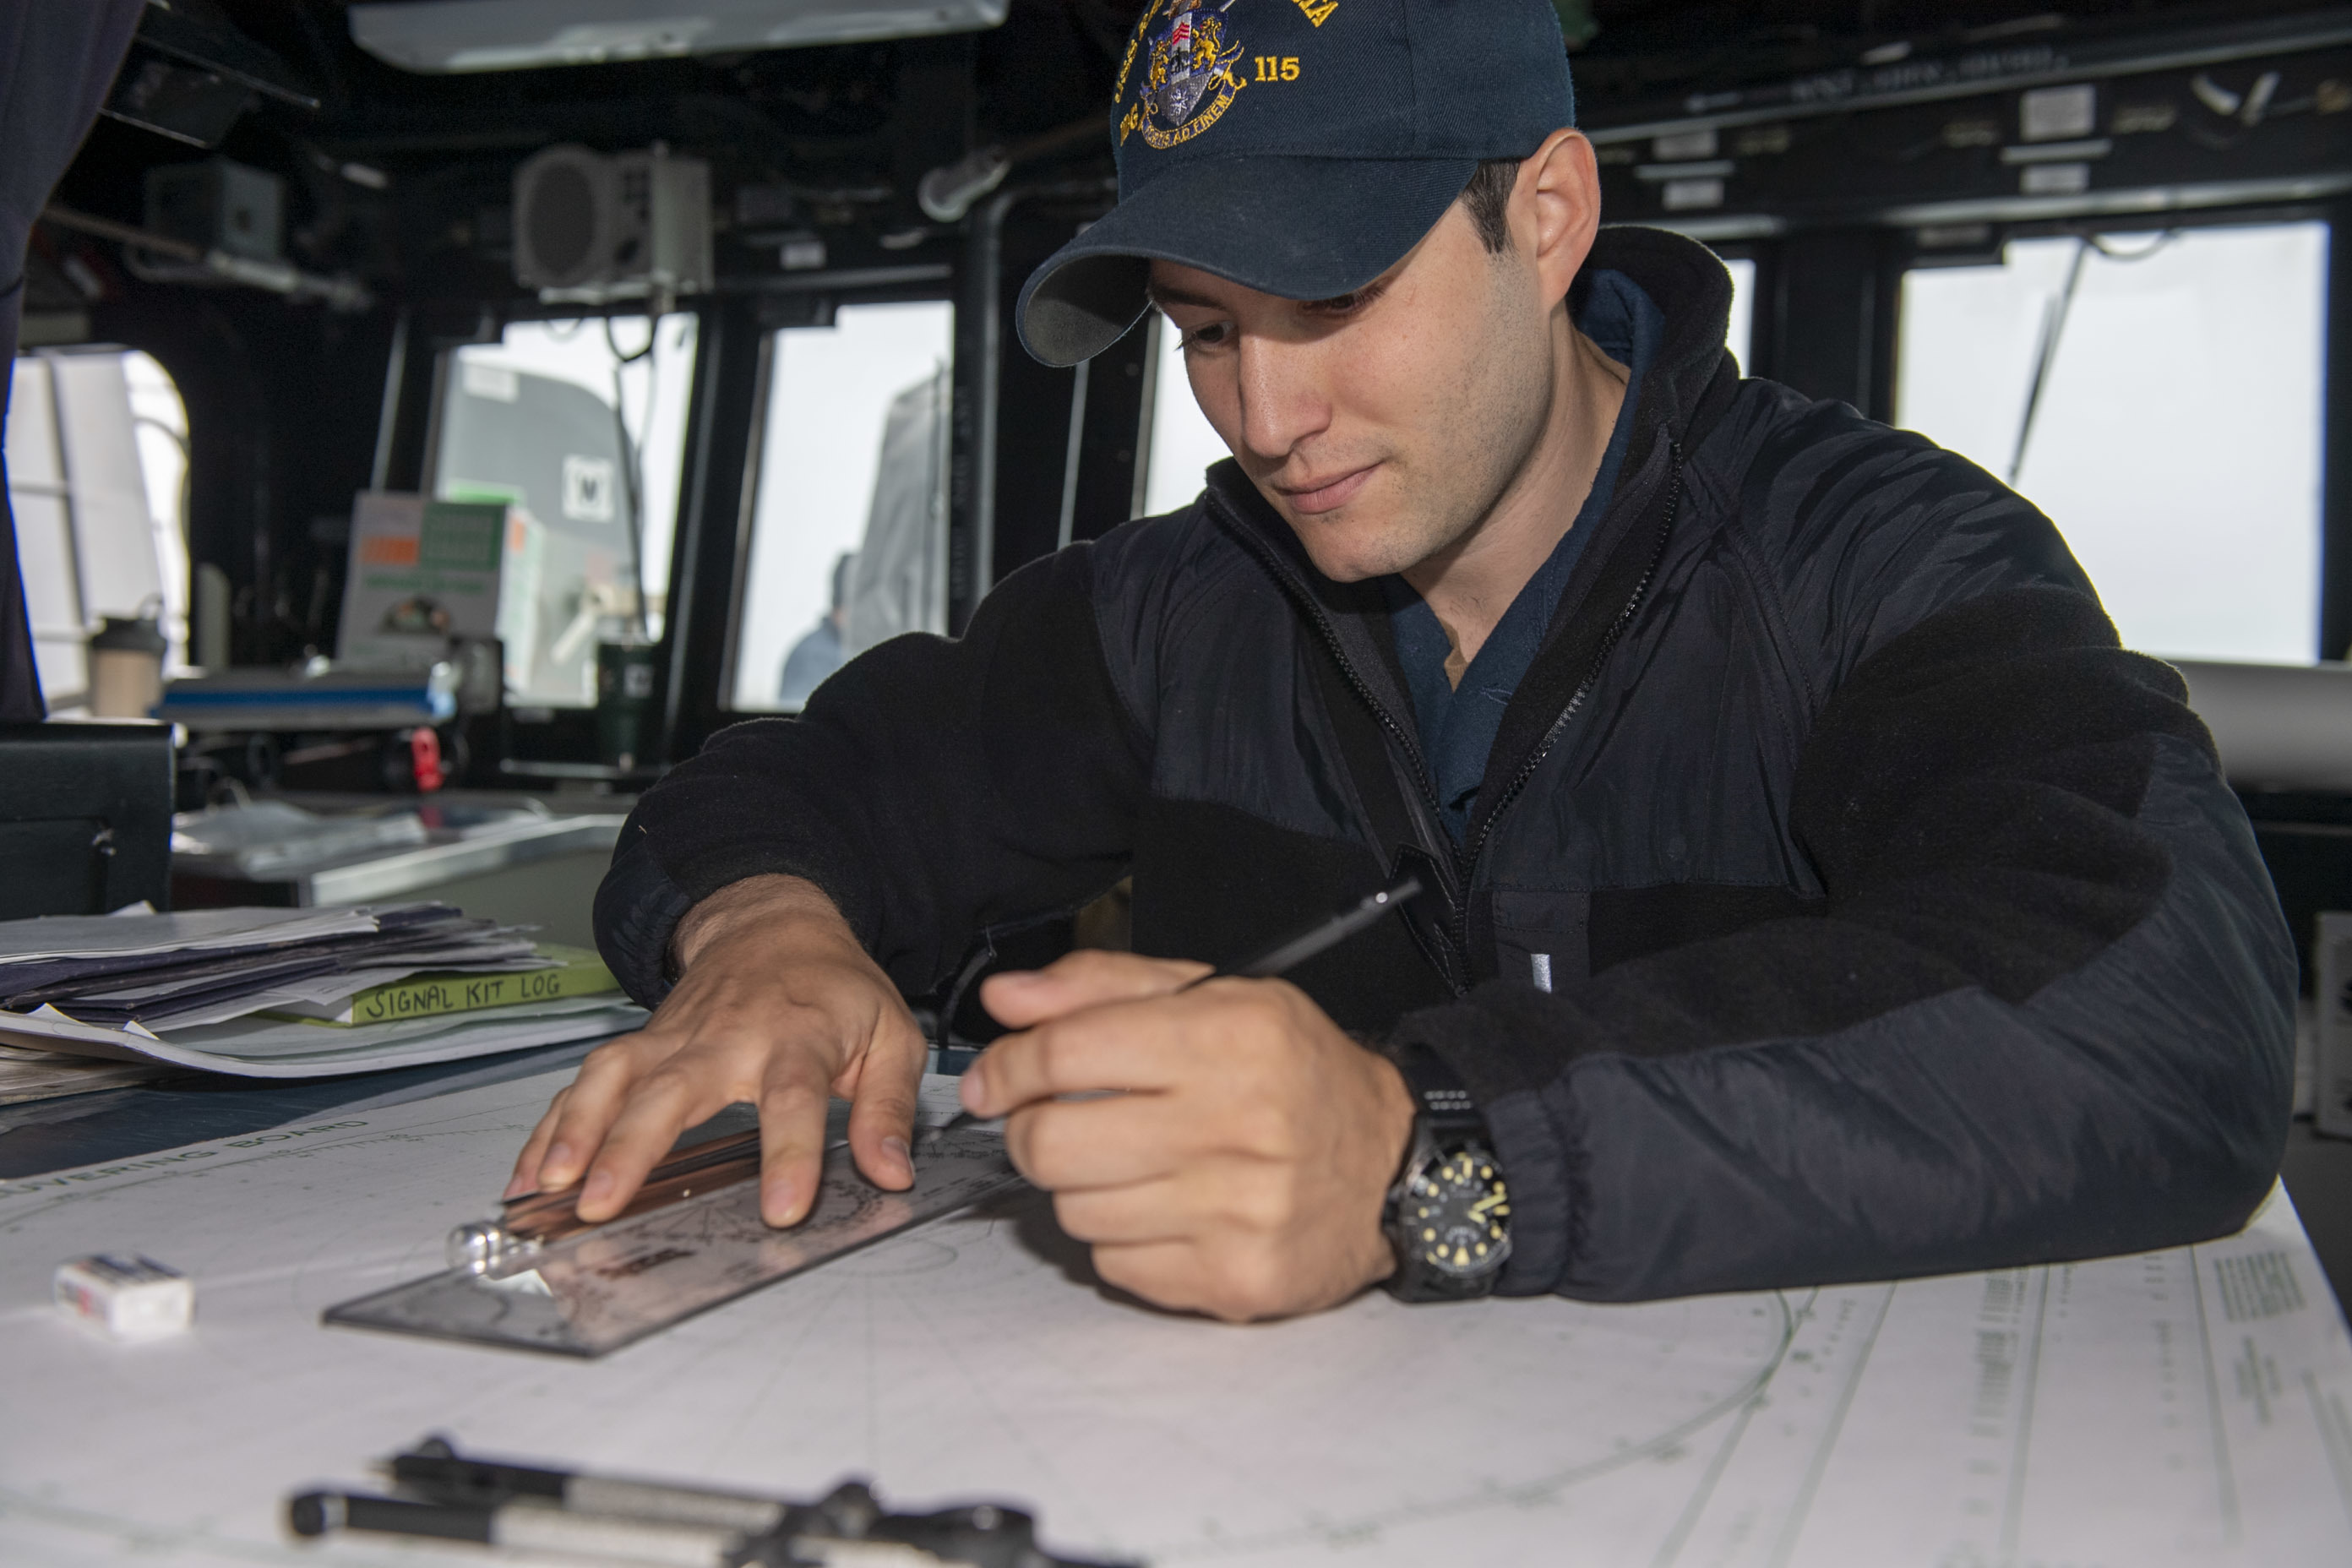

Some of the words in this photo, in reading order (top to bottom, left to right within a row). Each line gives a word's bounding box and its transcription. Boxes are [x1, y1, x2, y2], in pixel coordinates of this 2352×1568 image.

[1255, 56, 1300, 82] 115
[1193, 93, 1231, 133] FINEM
[366, 985, 454, 1018] SIGNAL
[466, 979, 504, 1008] KIT
[520, 974, 560, 999] LOG
[226, 1120, 369, 1149] BOARD
